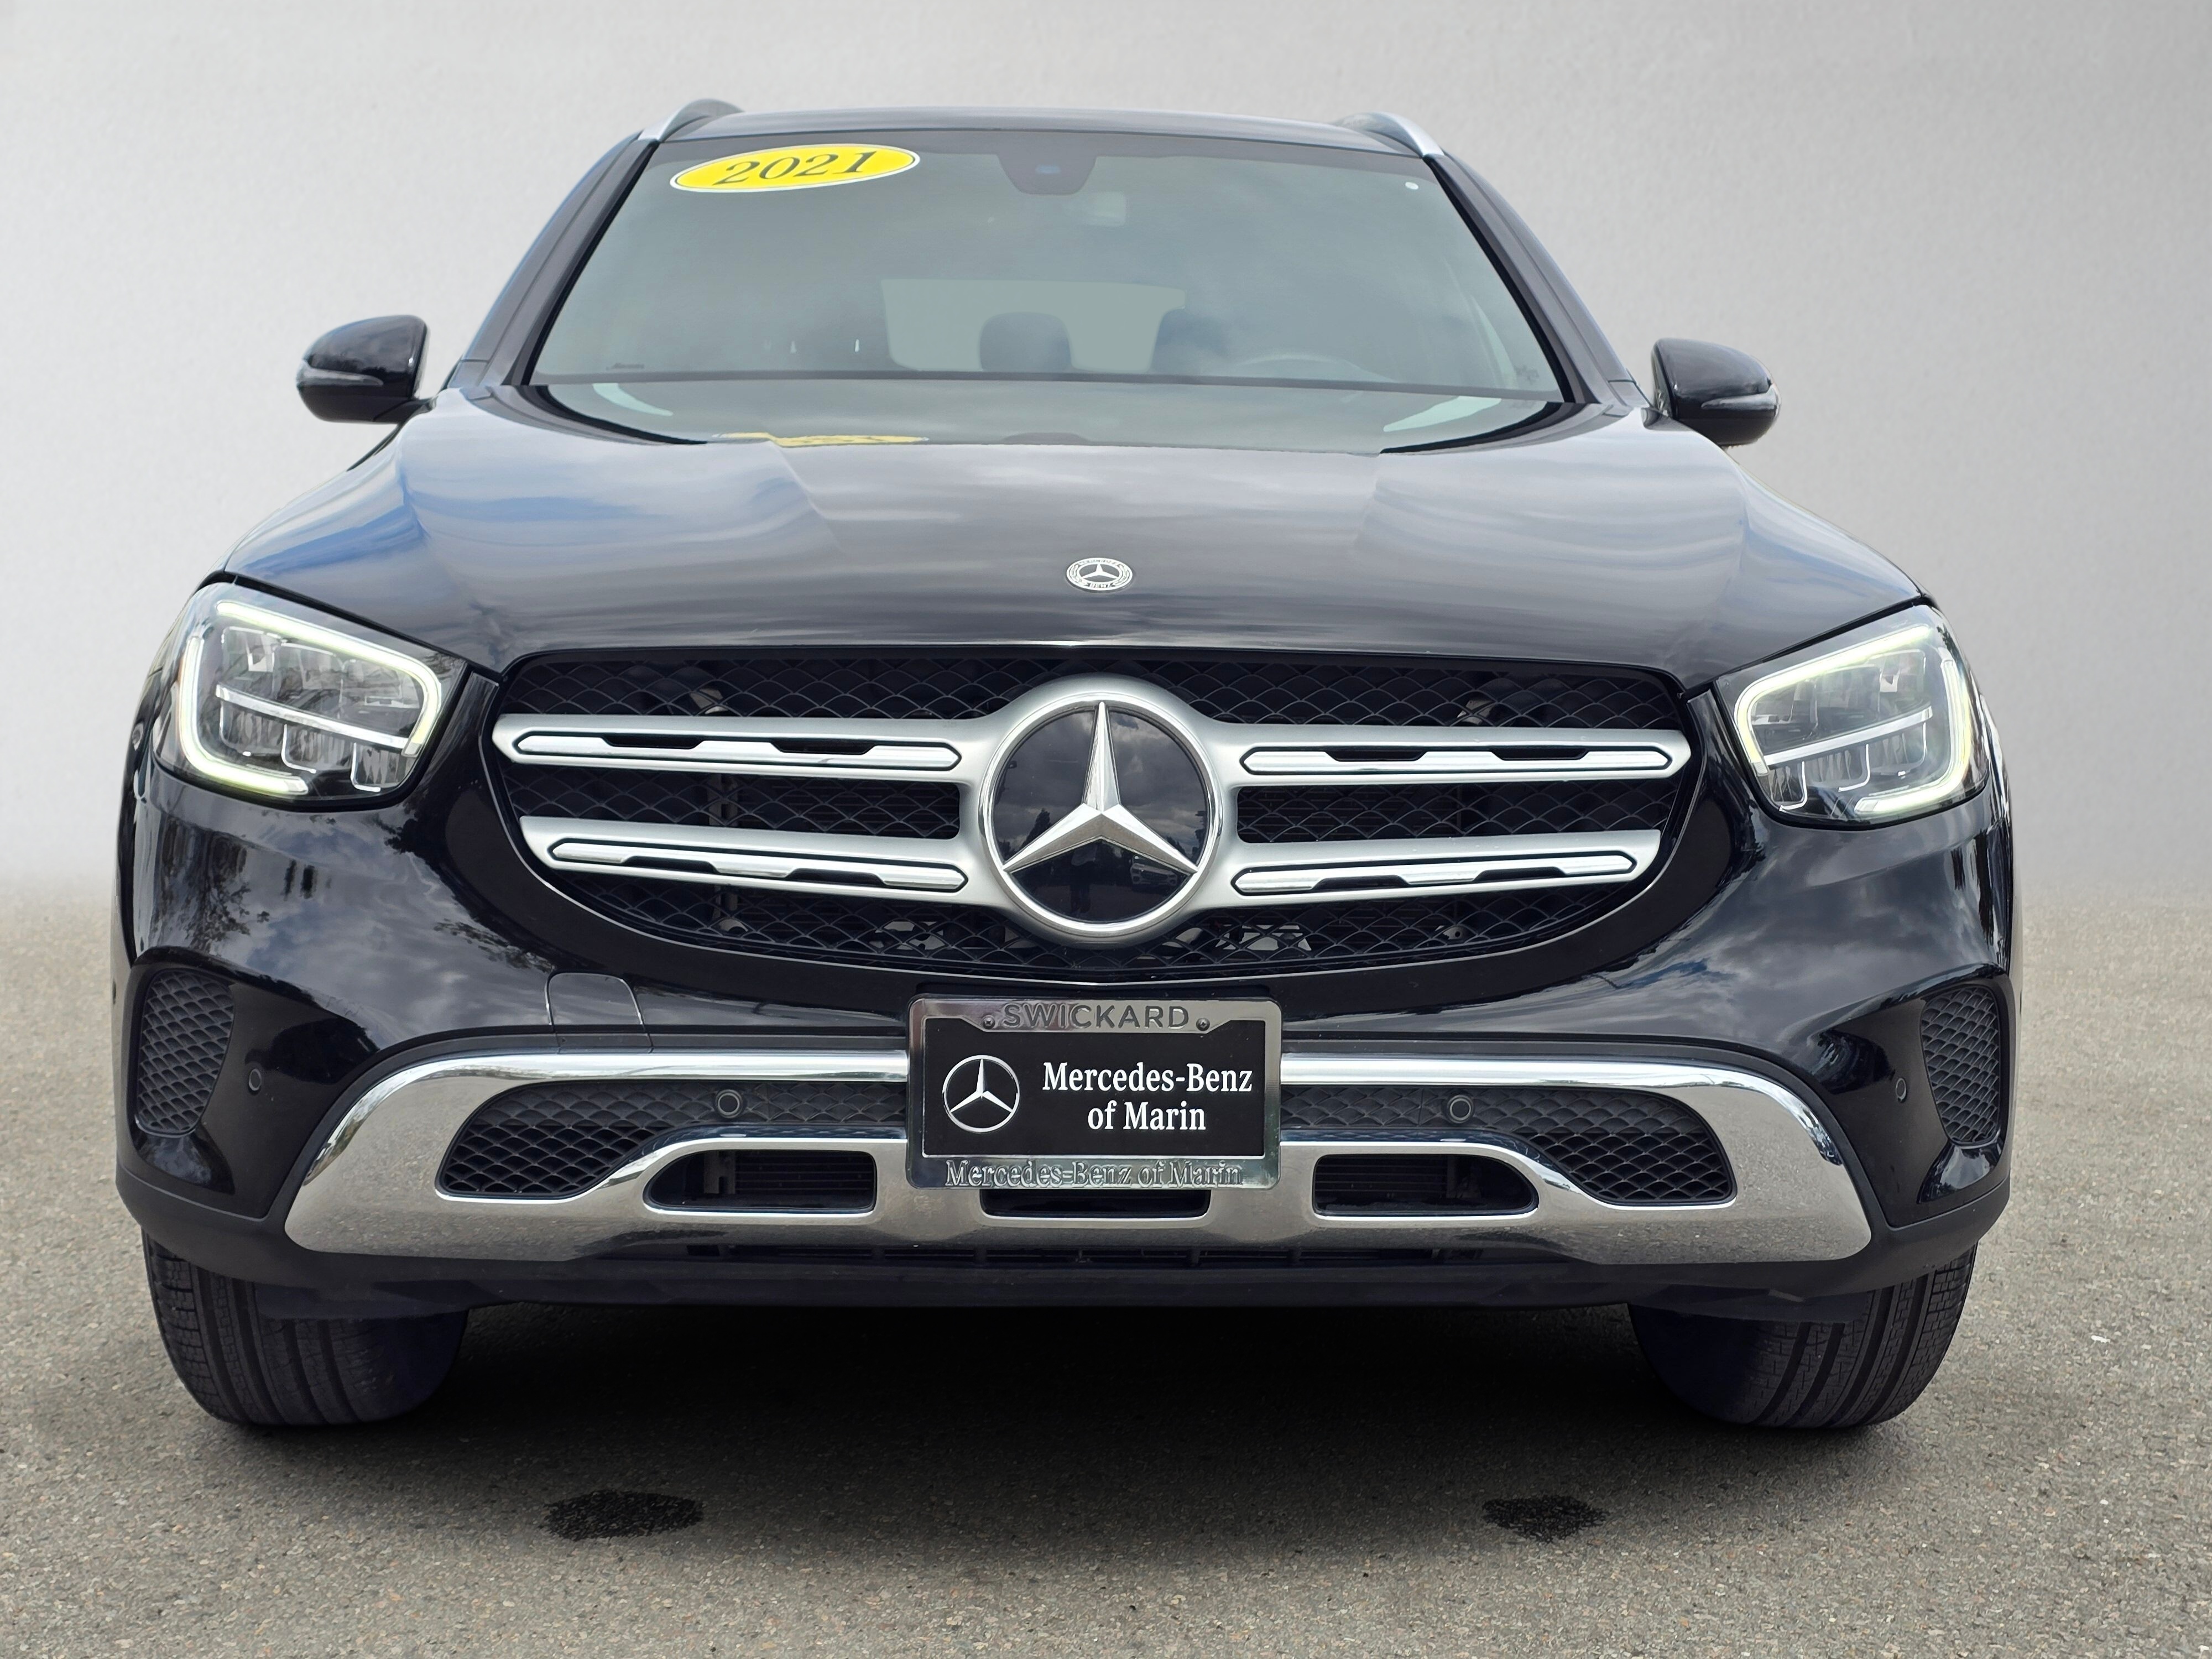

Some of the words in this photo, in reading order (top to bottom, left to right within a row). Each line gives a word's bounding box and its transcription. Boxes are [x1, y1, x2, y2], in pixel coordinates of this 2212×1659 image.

[712, 151, 877, 185] 2021
[1003, 1005, 1189, 1029] SWICKARD
[1043, 1062, 1253, 1092] Mercedes-Benz
[1088, 1100, 1116, 1130] of
[1123, 1100, 1207, 1130] Marin
[946, 1159, 1131, 1187] Mercedes-Benz
[1137, 1161, 1166, 1187] of
[1169, 1160, 1244, 1187] Marin
